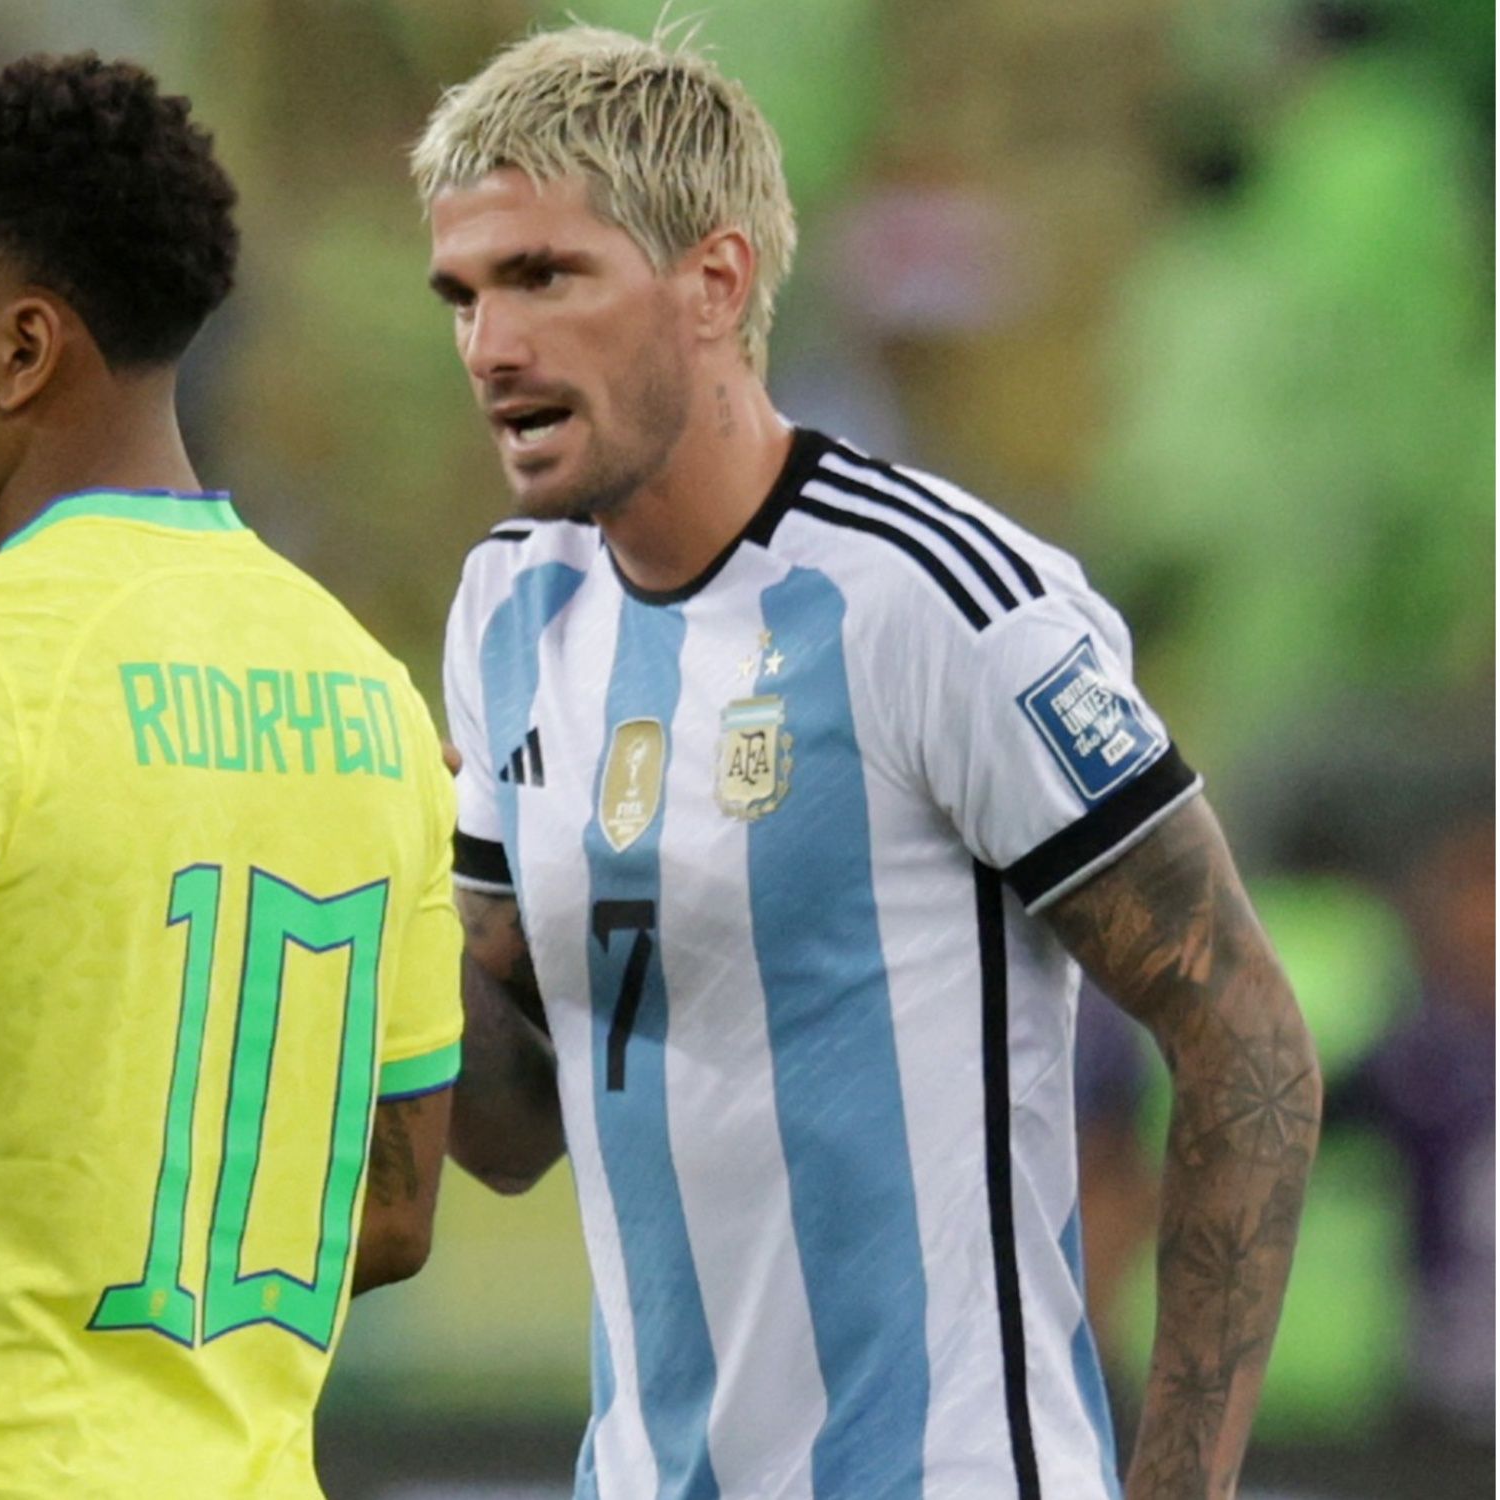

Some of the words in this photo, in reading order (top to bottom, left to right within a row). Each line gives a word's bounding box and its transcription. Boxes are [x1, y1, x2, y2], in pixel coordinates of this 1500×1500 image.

[117, 662, 403, 781] RODRYGO
[727, 730, 770, 786] AFA
[592, 899, 657, 1092] 7
[85, 862, 389, 1353] 10
